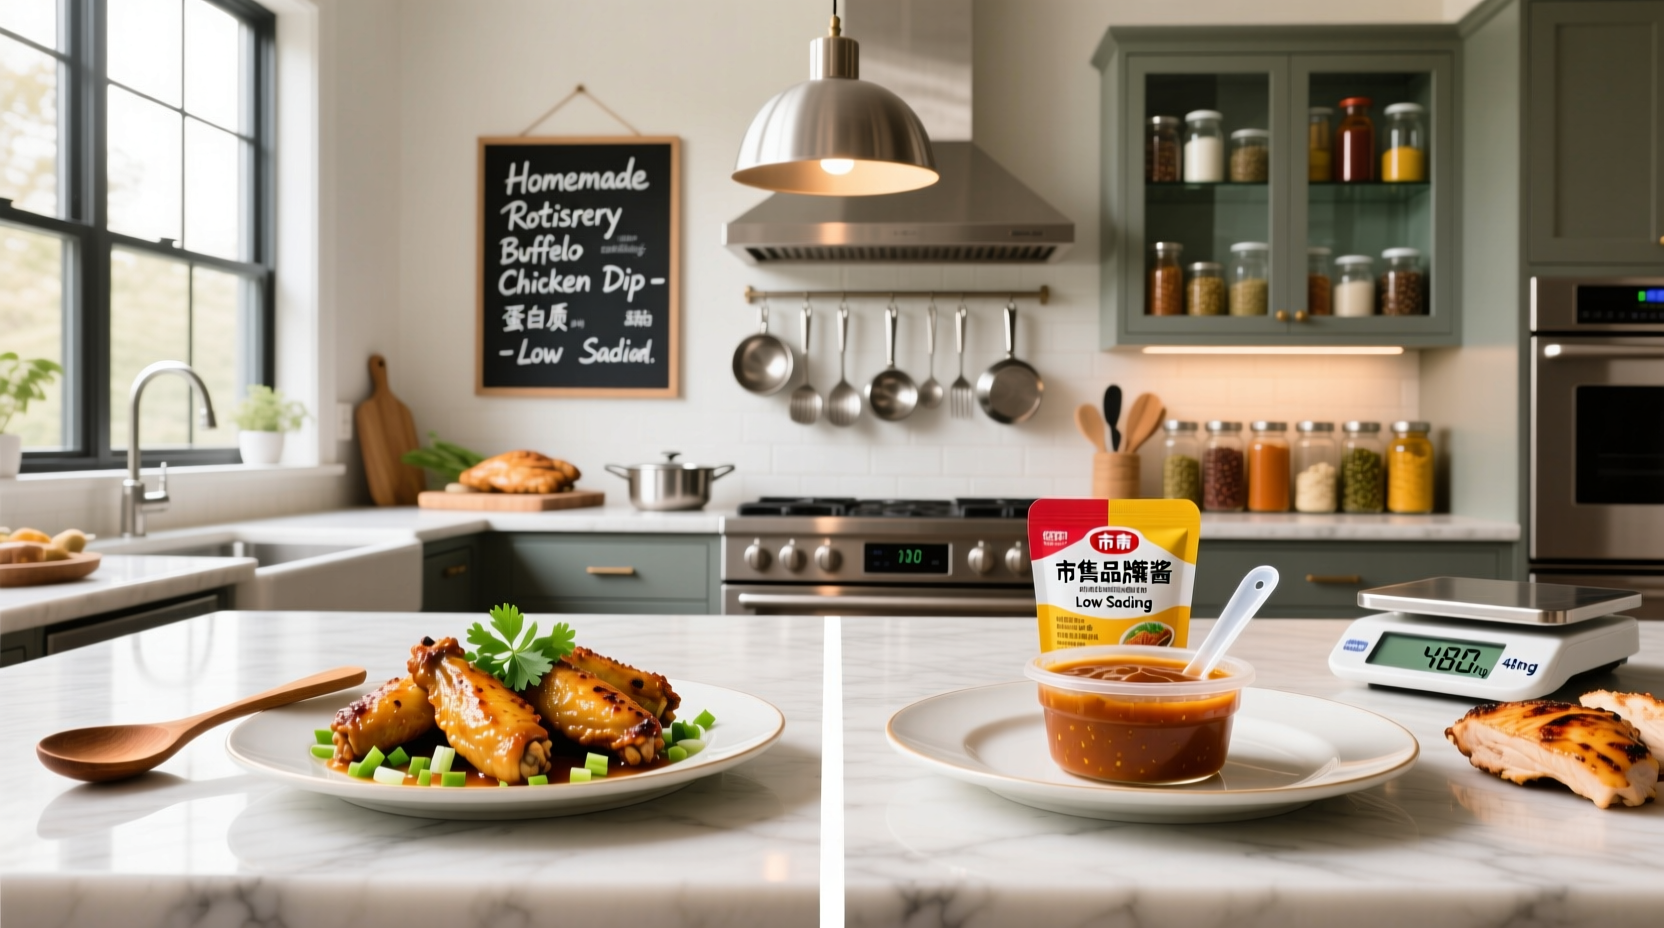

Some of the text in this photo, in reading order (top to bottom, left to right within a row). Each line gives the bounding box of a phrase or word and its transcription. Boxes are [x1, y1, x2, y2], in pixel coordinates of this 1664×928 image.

[504, 156, 650, 196] Homemade
[500, 200, 622, 240] Rotisrery
[499, 234, 584, 265] Buffelo
[498, 268, 591, 296] Chicken
[502, 302, 568, 332] 蛋白质
[1075, 595, 1153, 613] Low Sading
